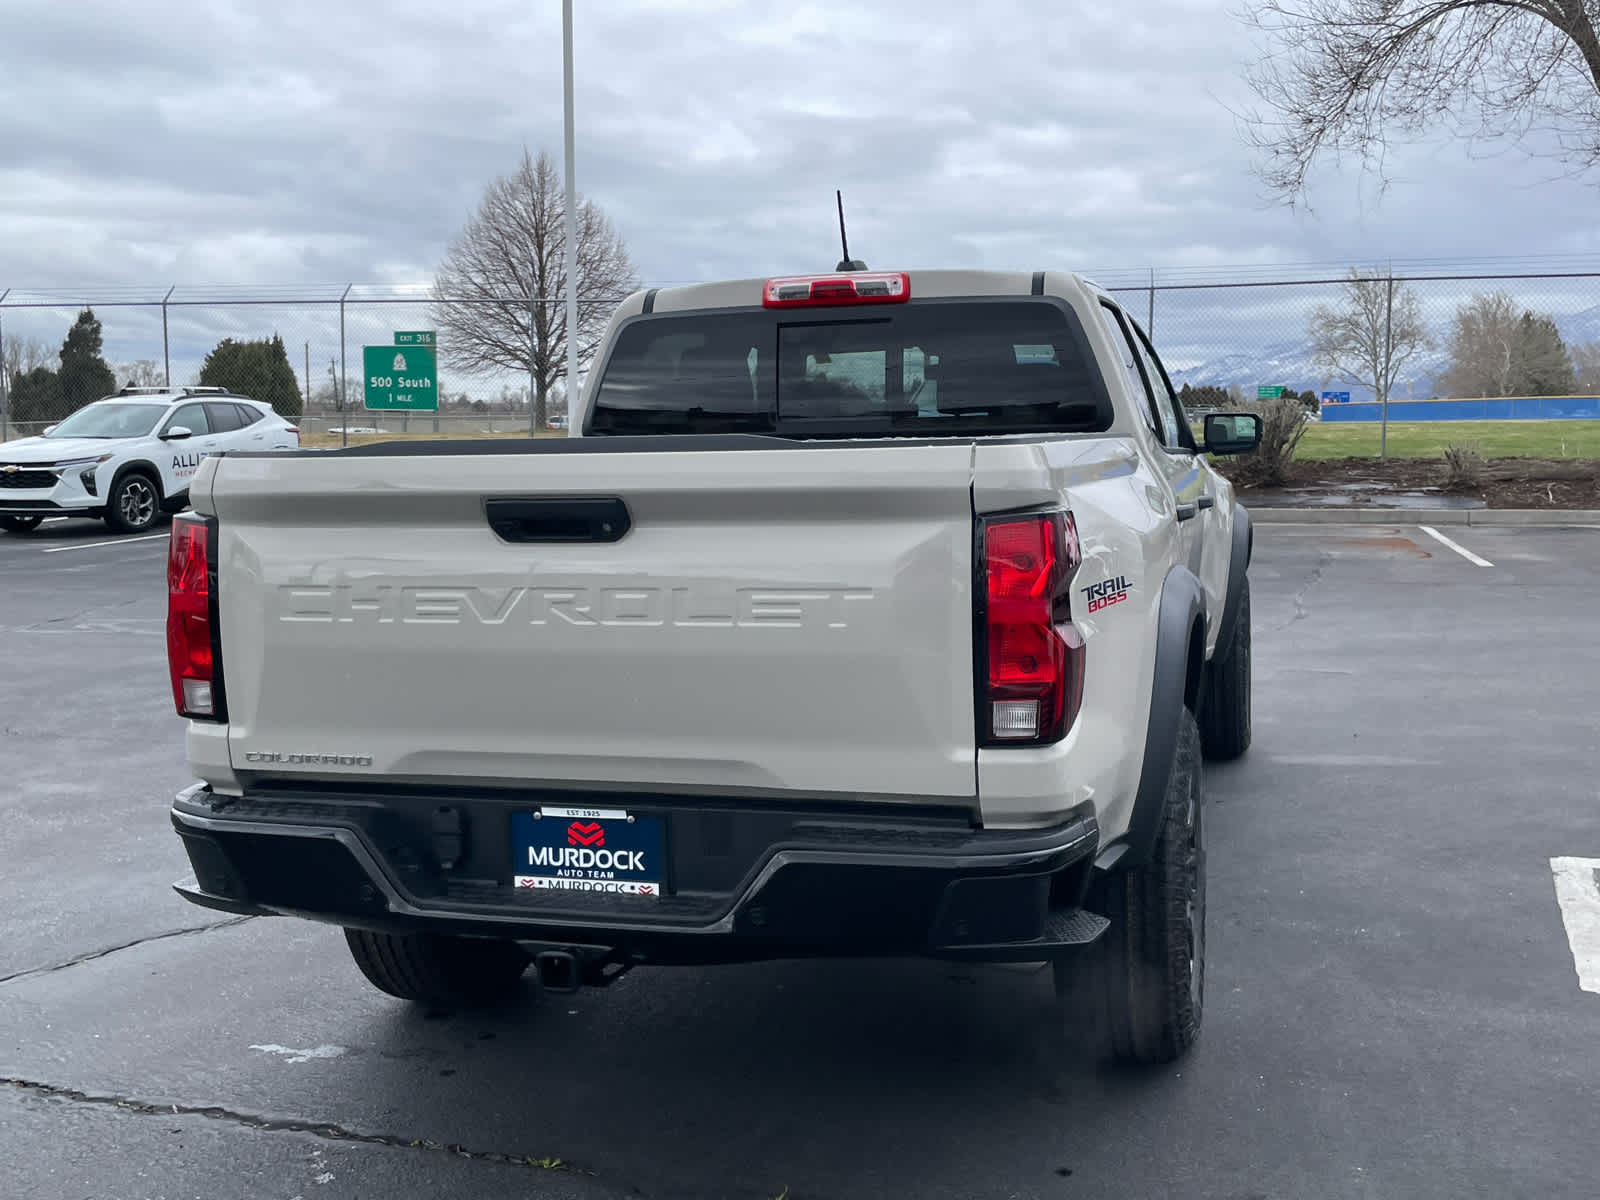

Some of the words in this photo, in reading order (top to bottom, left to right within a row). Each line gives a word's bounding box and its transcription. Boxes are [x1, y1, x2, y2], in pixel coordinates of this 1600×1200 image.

[370, 377, 393, 388] 500
[398, 377, 431, 388] South
[389, 393, 393, 403] 1
[171, 453, 208, 469] ALLI
[1081, 576, 1133, 601] TRAIL
[278, 585, 875, 628] CHEVROLET
[1088, 590, 1127, 613] BOSS
[246, 752, 373, 766] COLORADO
[528, 846, 645, 871] MURDOCK
[557, 869, 583, 877] AUTO
[587, 871, 614, 879] TEAM
[549, 879, 625, 893] MURDOCK
